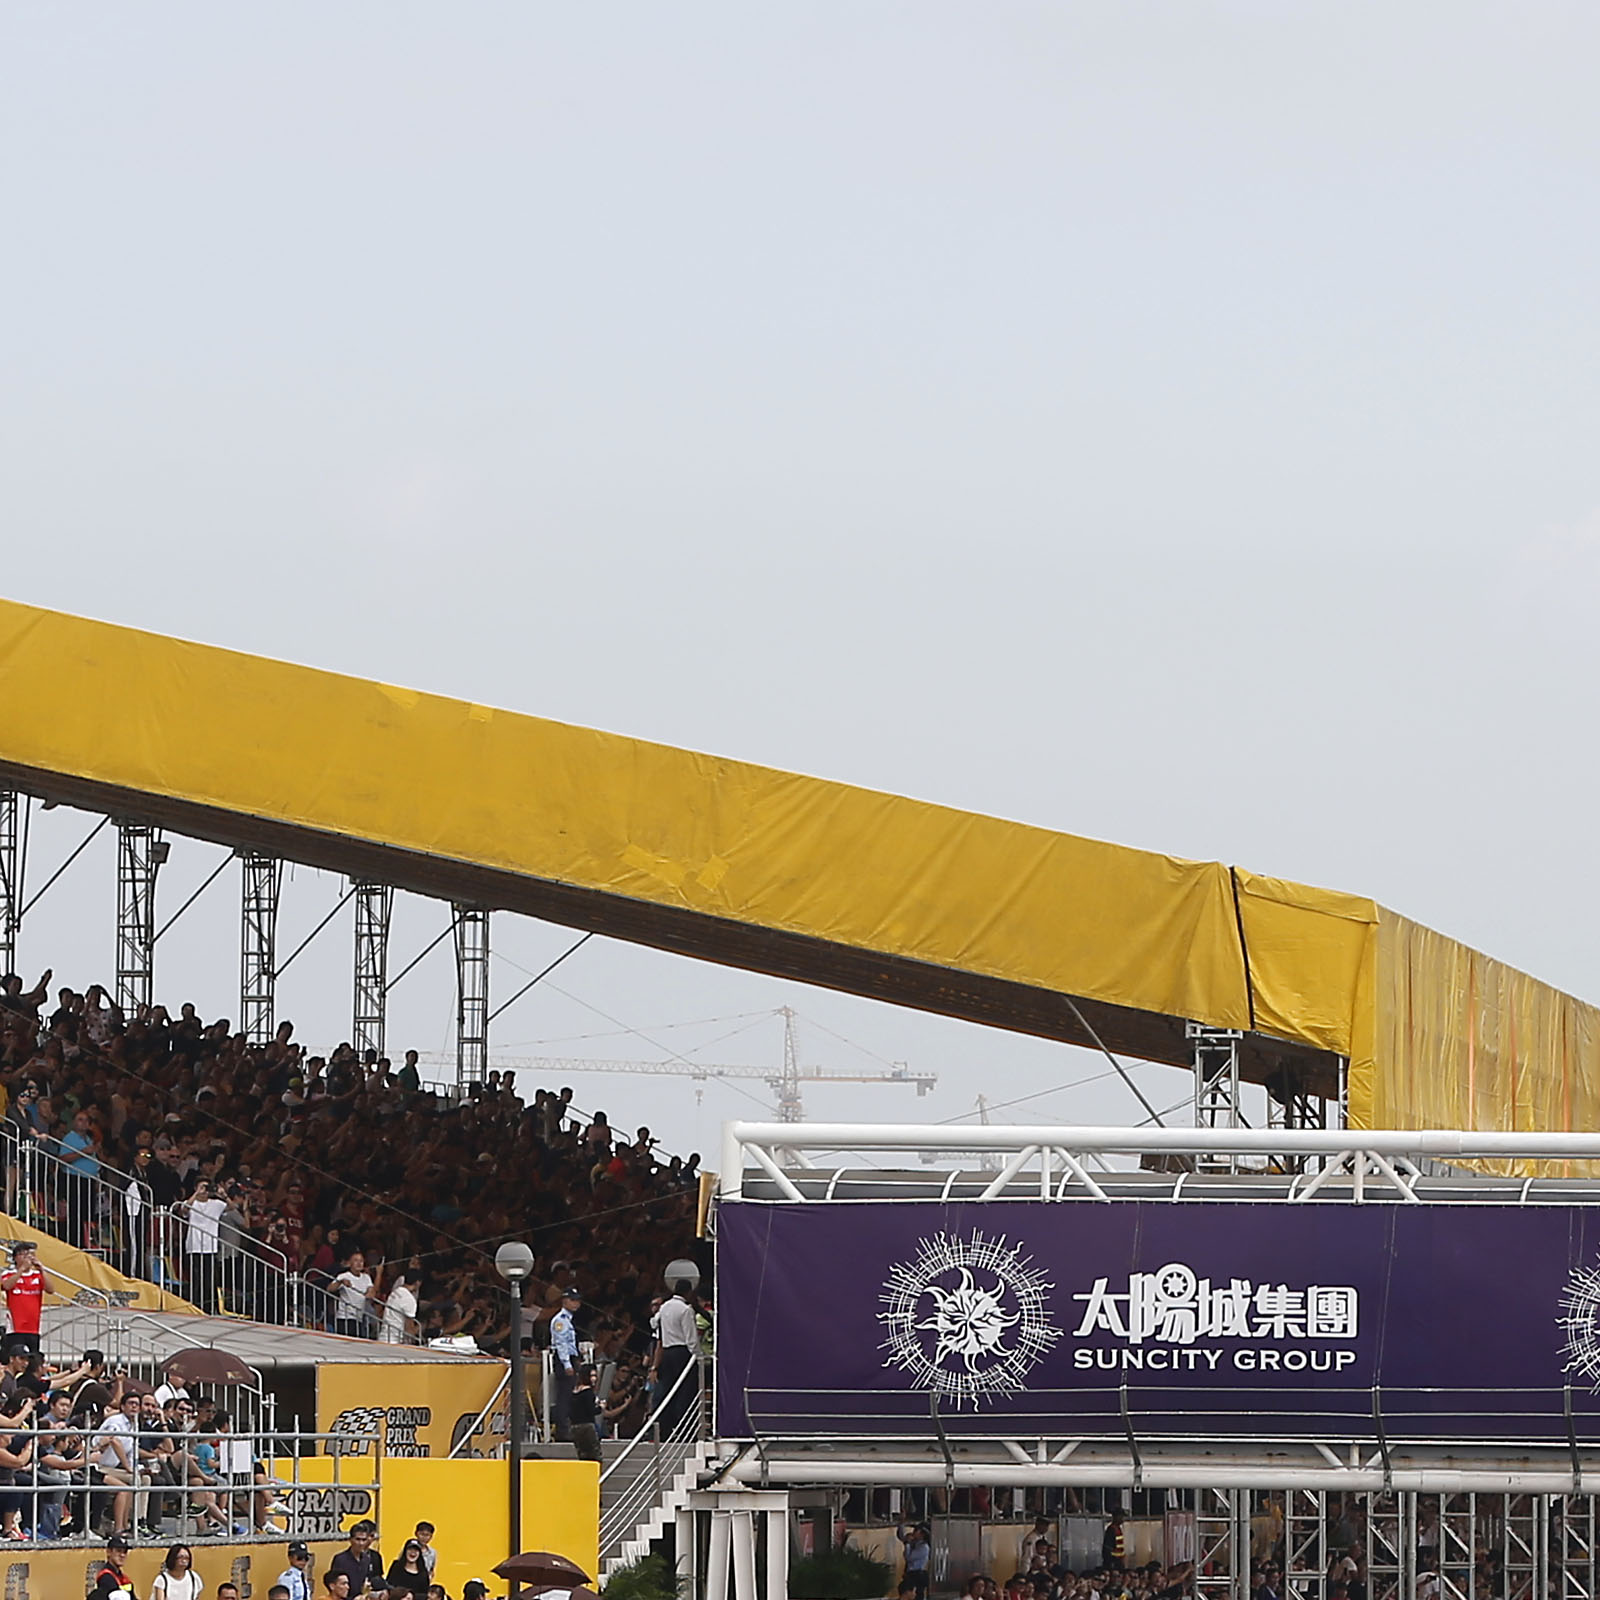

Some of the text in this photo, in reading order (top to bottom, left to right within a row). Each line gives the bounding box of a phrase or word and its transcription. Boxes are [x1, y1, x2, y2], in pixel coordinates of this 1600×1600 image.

[1073, 1264, 1357, 1344] 太陽城集團
[1074, 1349, 1355, 1370] SUNCITY GROUP
[386, 1407, 430, 1426] GRAND
[386, 1428, 416, 1445] PRIX
[288, 1491, 371, 1515] GRAND
[287, 1516, 342, 1534] PRIX
